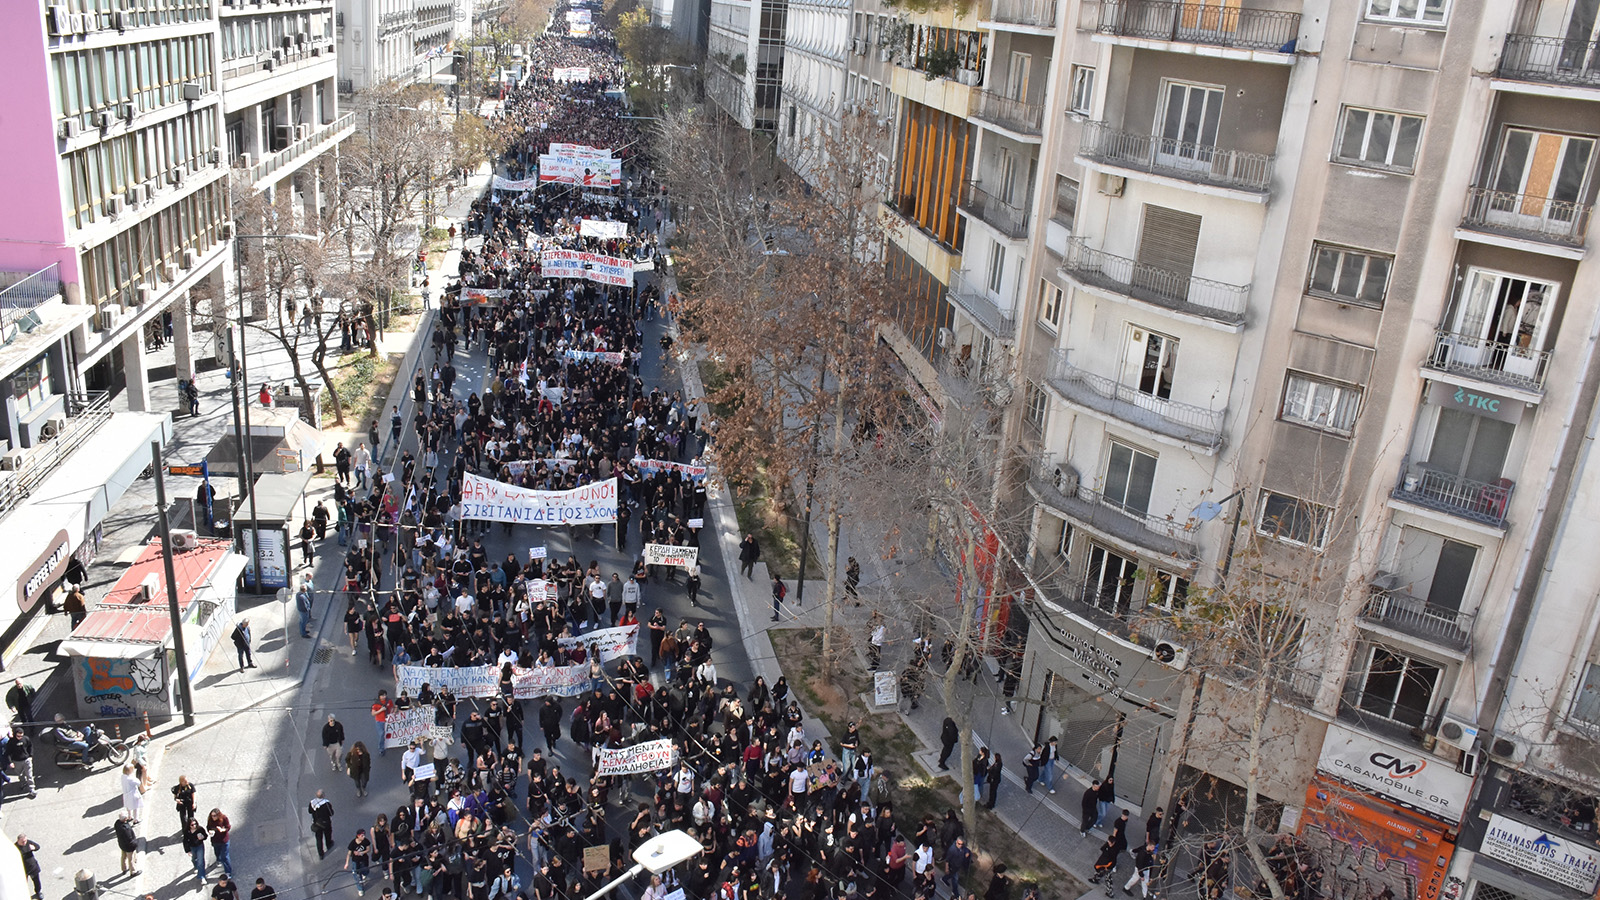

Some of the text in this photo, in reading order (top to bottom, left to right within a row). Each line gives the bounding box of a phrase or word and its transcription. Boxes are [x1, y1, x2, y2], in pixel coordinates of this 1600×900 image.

[1467, 394, 1500, 412] TKC
[463, 504, 618, 521] ΣΙΒΙΤΑΝΙΔΕΙΟΣ ΣΧΟΛΗ
[26, 562, 50, 597] COFFEE
[387, 711, 406, 723] ΔΕΝ
[603, 758, 621, 767] ΔΕΝ
[1370, 752, 1417, 779] CM
[1334, 759, 1449, 807] CASAMOBILE.GR
[1387, 820, 1412, 833] ΛΙΑΝΙΚΗ
[1490, 827, 1598, 874] ATHANASIADIS TRAVEL
